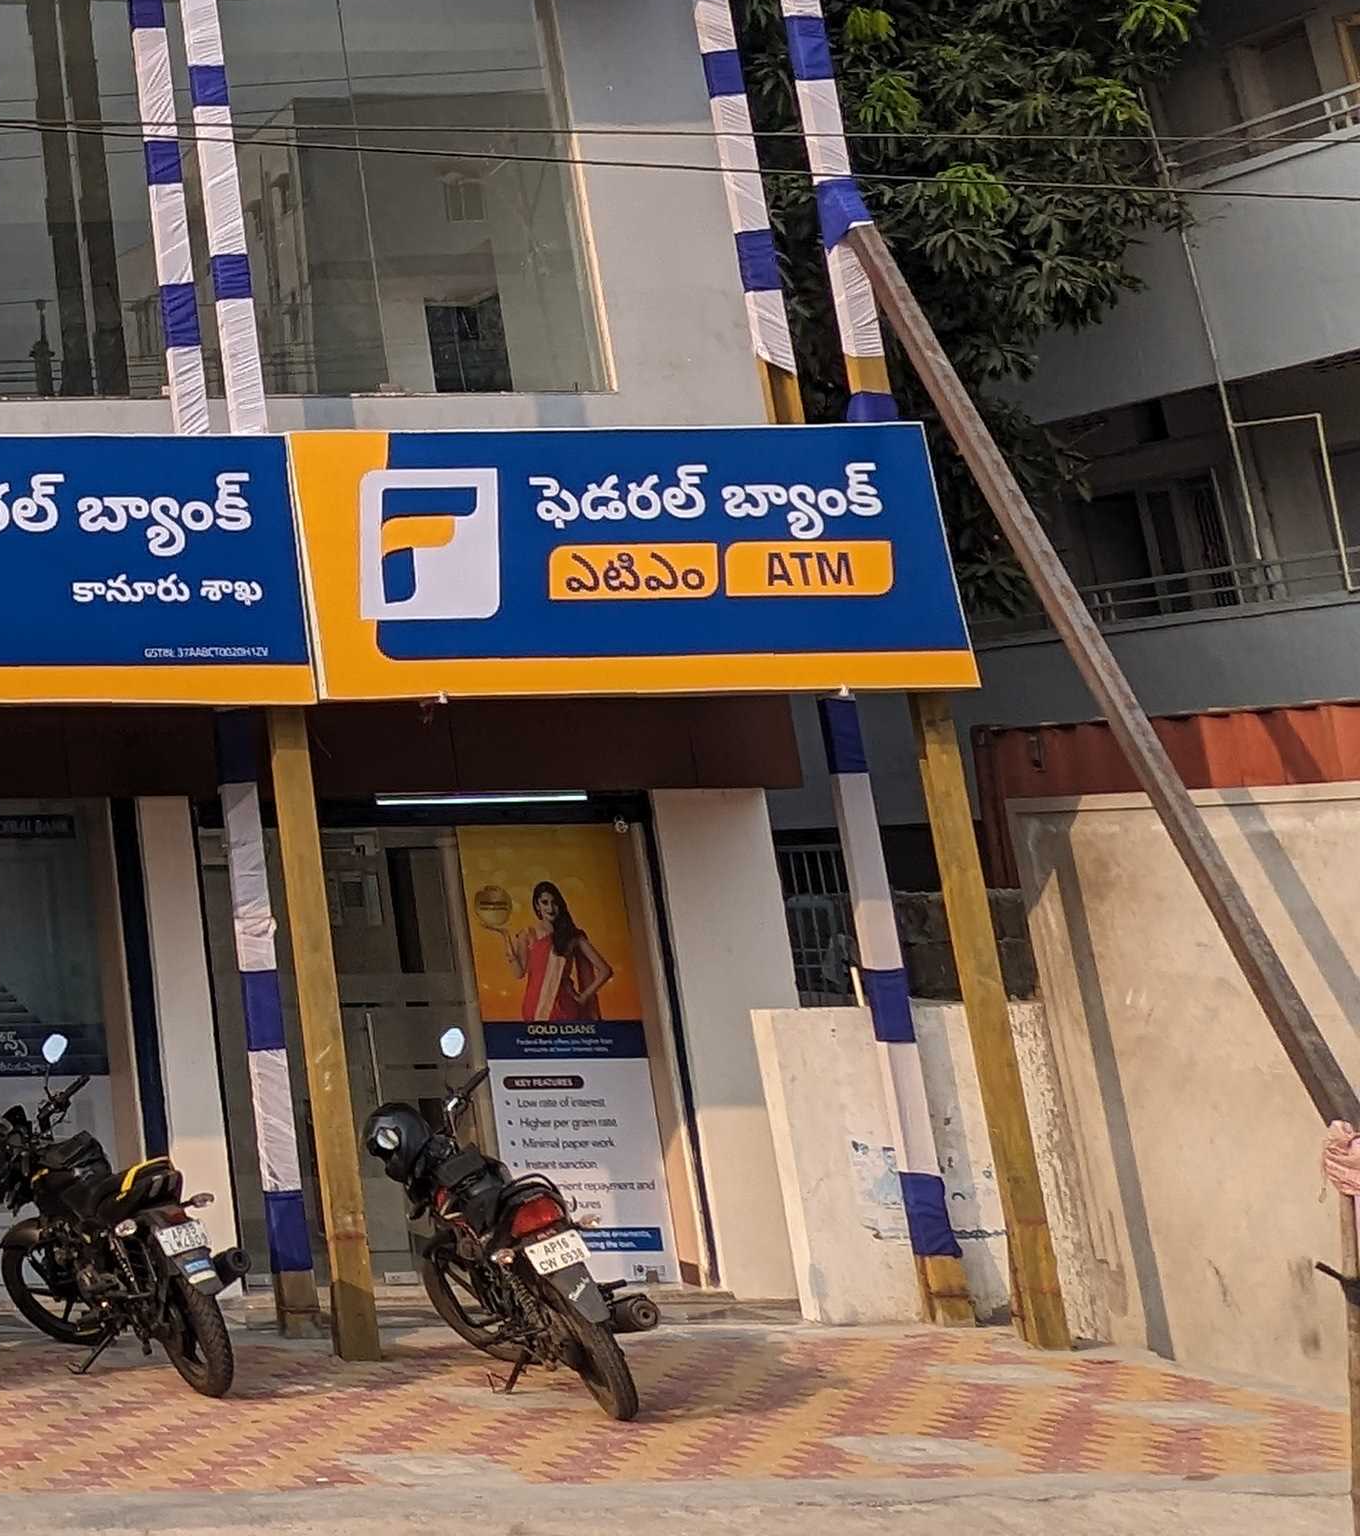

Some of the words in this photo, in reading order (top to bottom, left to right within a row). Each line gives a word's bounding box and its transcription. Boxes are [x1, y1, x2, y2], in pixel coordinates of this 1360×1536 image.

[528, 464, 708, 529] ఫెడరల్
[722, 462, 883, 540] బ్యాంక్
[77, 472, 252, 557] బ్యాంక్
[564, 551, 706, 593] ఎటిఎం
[766, 551, 855, 588] ATM
[72, 573, 190, 604] కానూరు
[199, 578, 263, 606] శాఖ
[527, 1024, 557, 1035] GOLD
[560, 1024, 597, 1035] LOANS
[514, 1078, 531, 1088] KEY
[533, 1078, 574, 1087] FEATURES
[517, 1098, 538, 1108] Low
[539, 1099, 557, 1108] rate
[559, 1097, 570, 1108] of
[571, 1097, 606, 1108] interest
[519, 1117, 552, 1131] Higher
[553, 1119, 570, 1129] per
[598, 1117, 618, 1128] rate
[522, 1137, 561, 1148] Minimal
[562, 1139, 590, 1150] paper
[591, 1137, 616, 1148] work
[525, 1159, 557, 1169] Instant
[558, 1159, 598, 1170] sanction
[584, 1180, 635, 1193] repayment
[636, 1179, 655, 1191] and
[543, 1238, 570, 1256] AP16
[539, 1257, 558, 1272] CW
